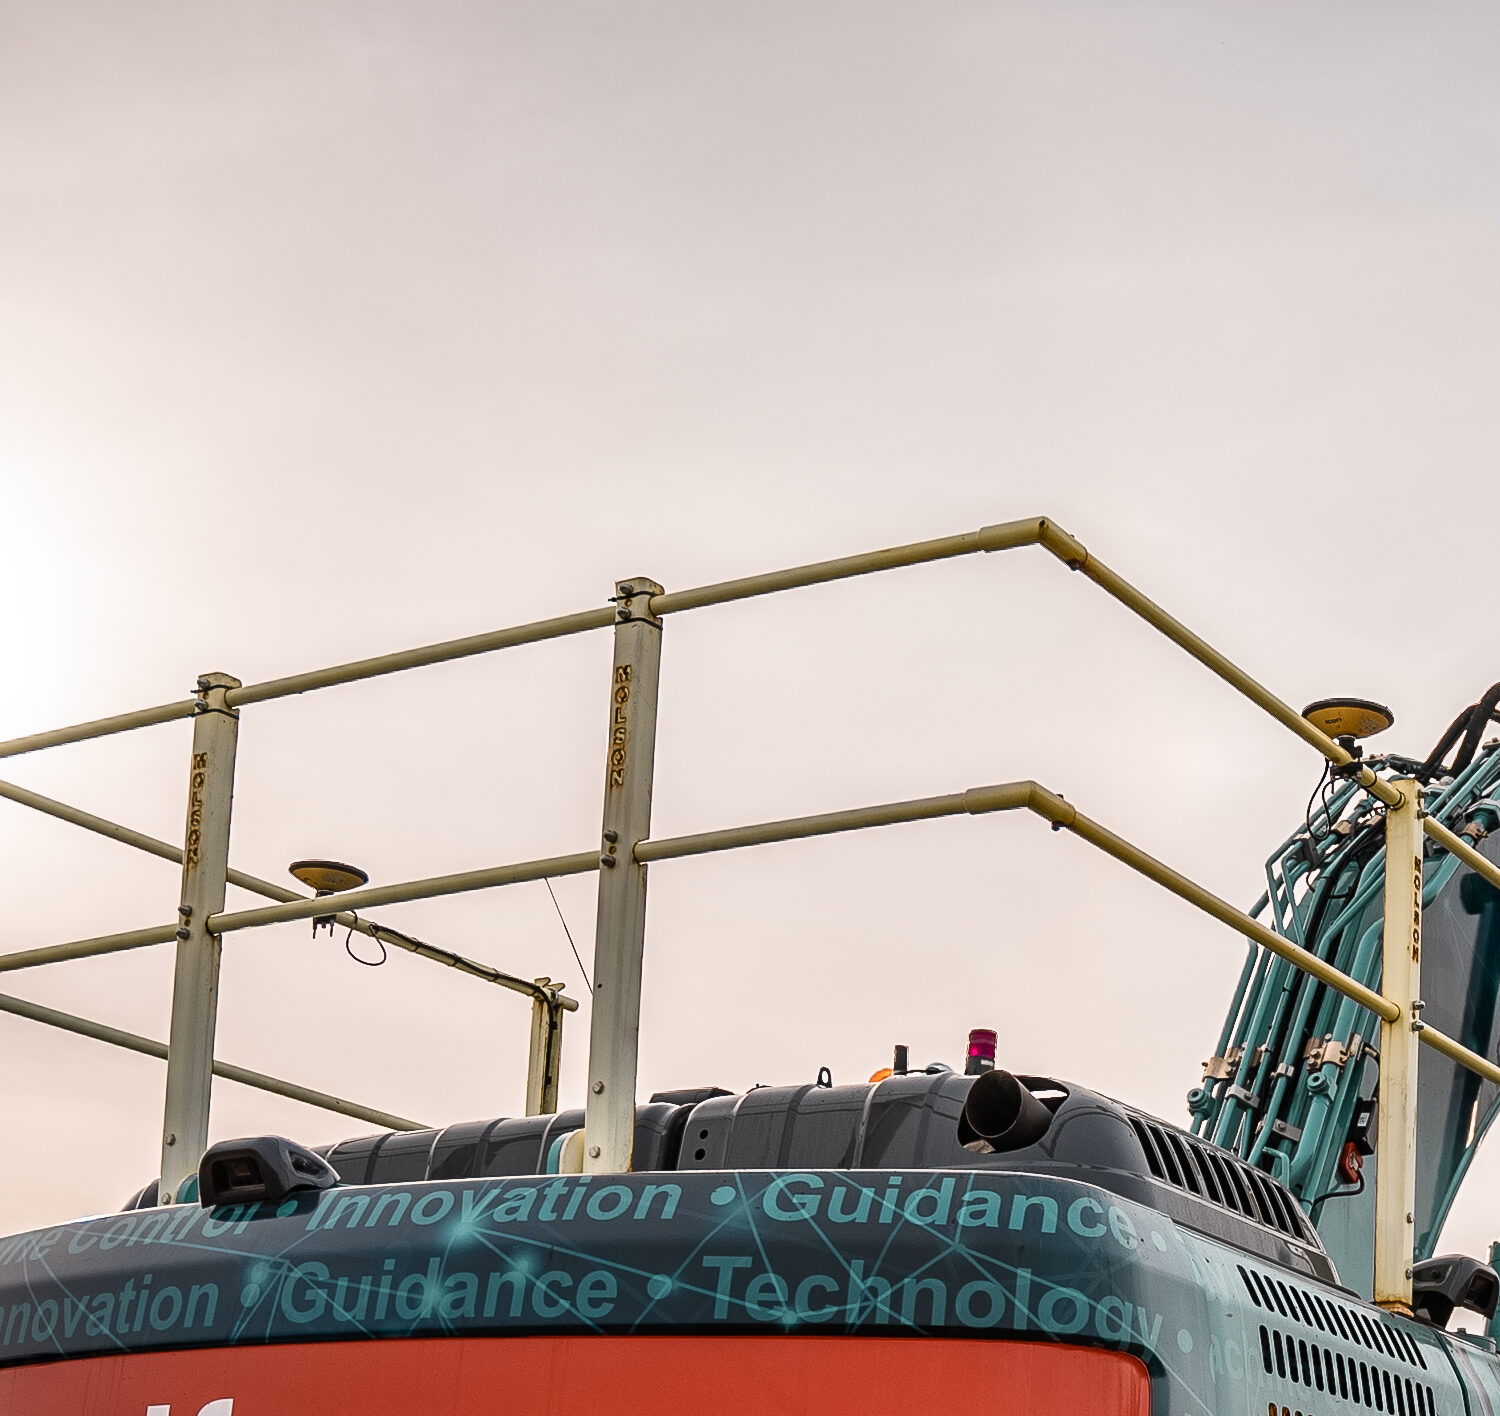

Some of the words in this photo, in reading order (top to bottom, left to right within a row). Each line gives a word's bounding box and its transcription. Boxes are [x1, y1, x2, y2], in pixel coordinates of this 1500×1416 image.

[610, 664, 632, 789] MOLSON
[1412, 855, 1421, 964] MOLSON
[305, 1177, 682, 1232] Innovation
[762, 1173, 1138, 1249] Guidance
[0, 1273, 219, 1346] novation
[281, 1257, 618, 1324] Guidance
[702, 1255, 1164, 1363] Technology
